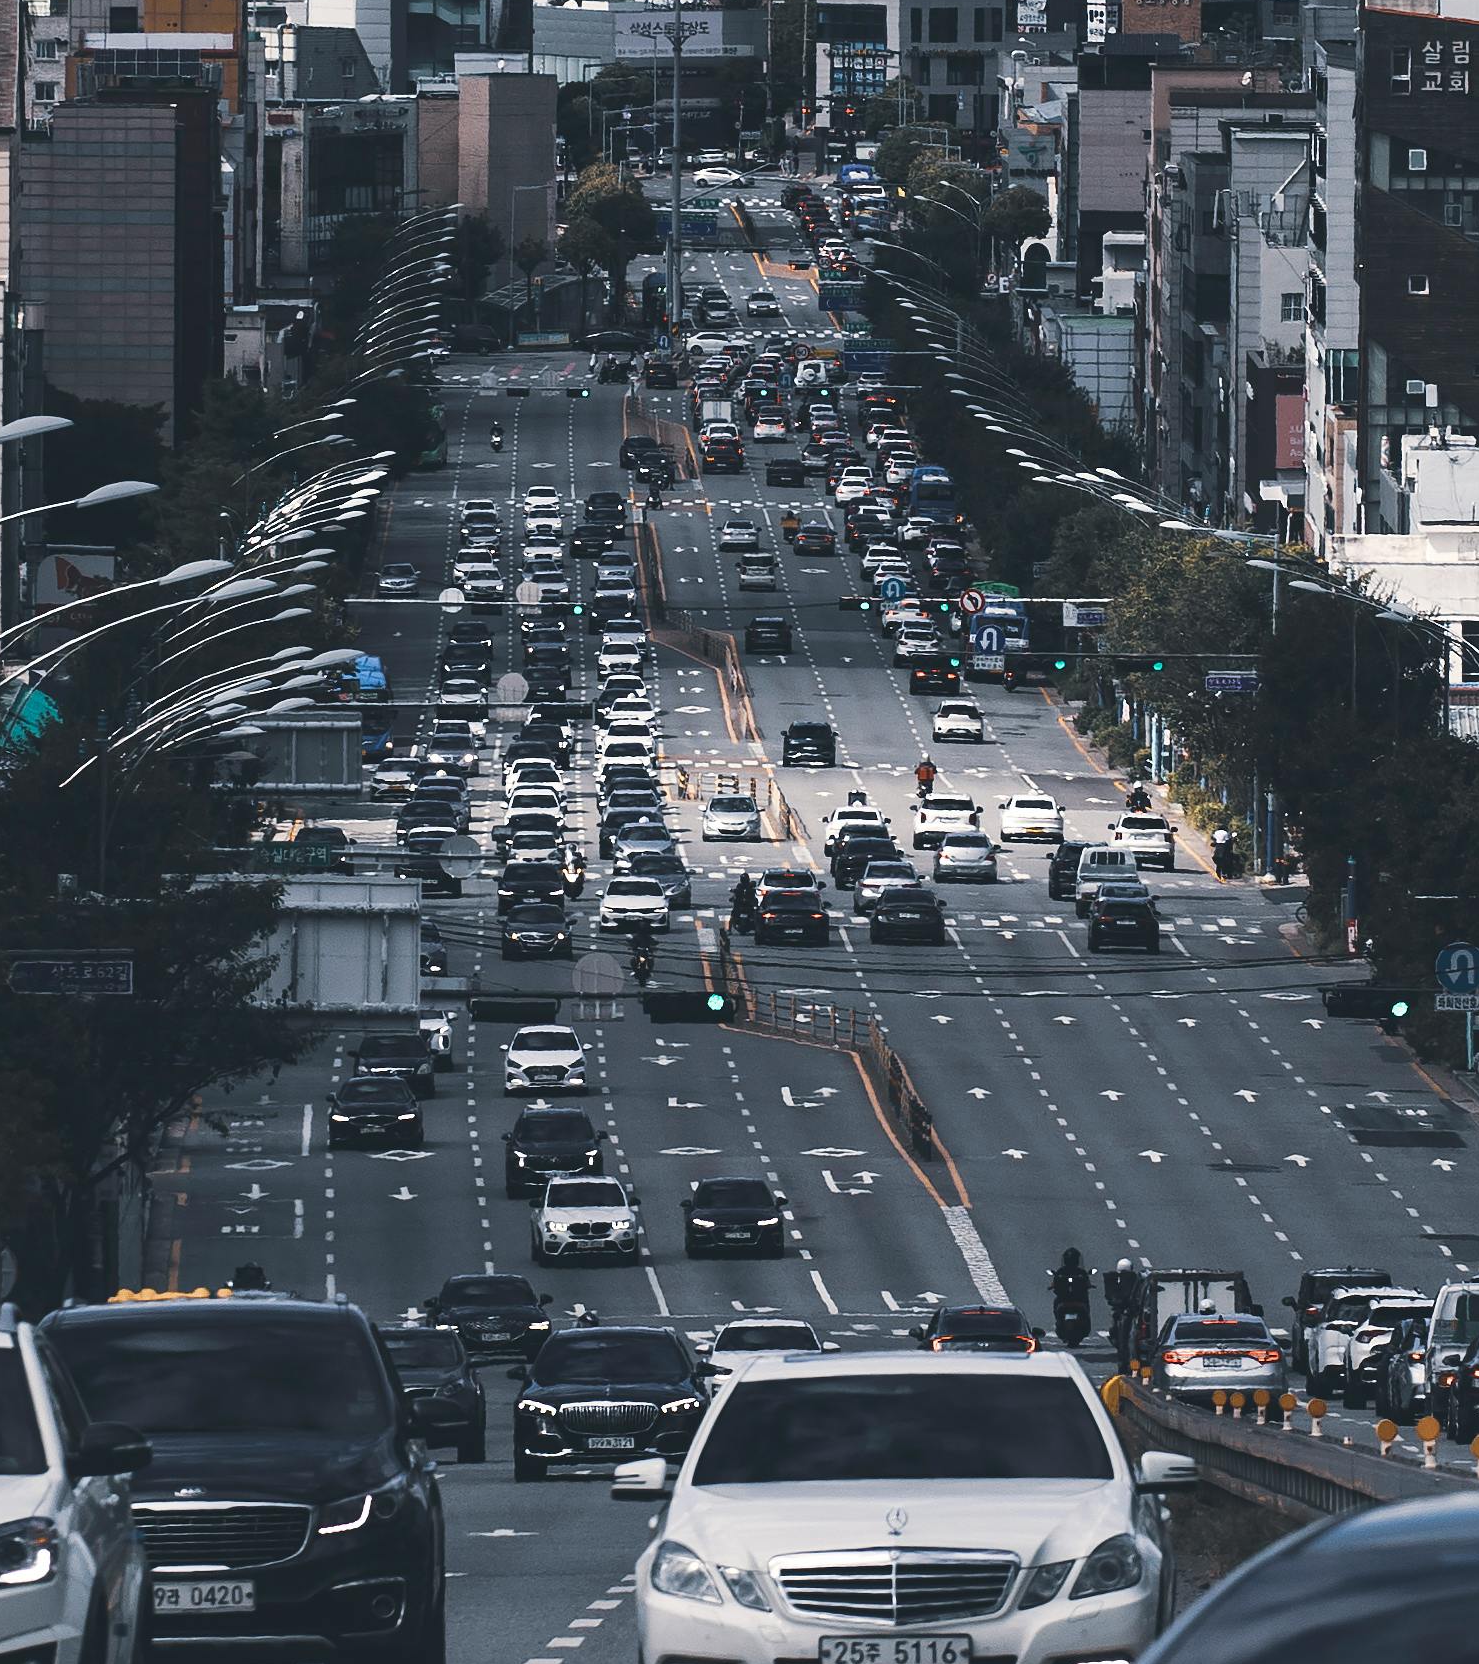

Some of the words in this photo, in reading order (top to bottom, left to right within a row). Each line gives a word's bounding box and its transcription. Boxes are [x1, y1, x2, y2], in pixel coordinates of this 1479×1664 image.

[1421, 40, 1471, 65] 살림
[1421, 70, 1470, 95] 교회
[154, 1587, 180, 1607] 9라
[190, 1585, 245, 1606] 0420
